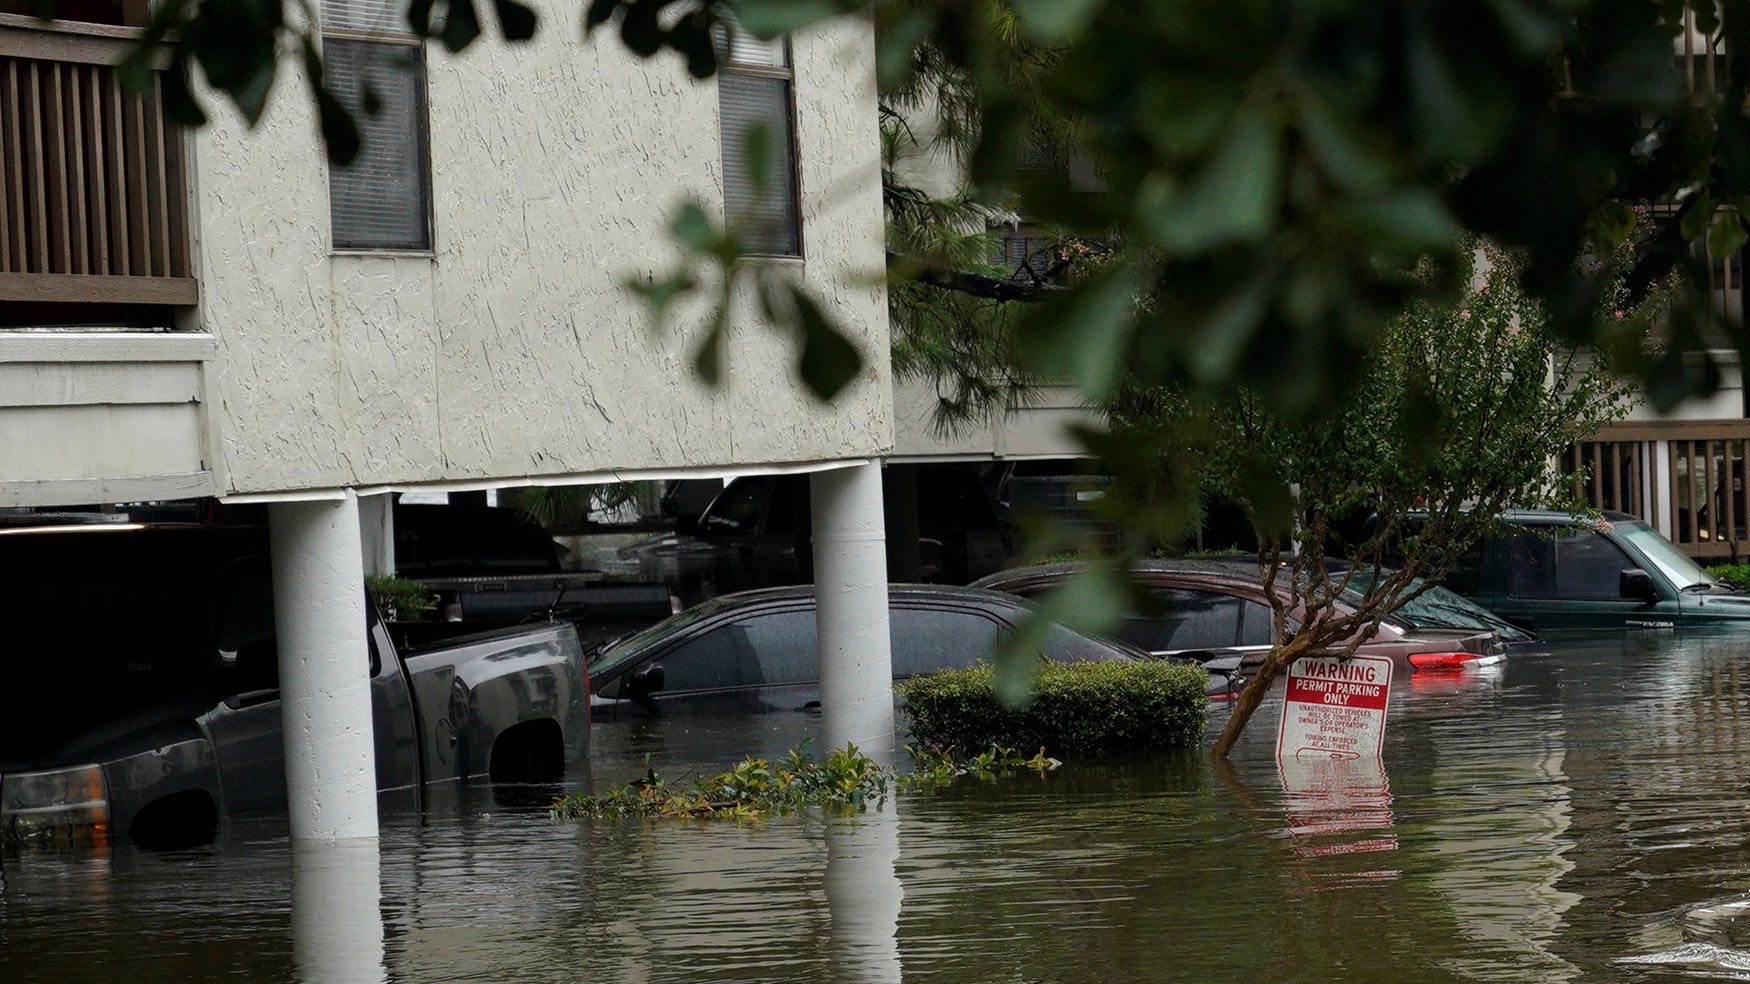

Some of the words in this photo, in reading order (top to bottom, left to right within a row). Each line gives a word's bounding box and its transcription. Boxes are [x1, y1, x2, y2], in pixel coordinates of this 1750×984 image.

[1305, 661, 1376, 682] WARNING
[1296, 679, 1334, 692] PERMIT
[1336, 683, 1380, 697] PARKING
[1323, 693, 1350, 705] ONLY
[1299, 705, 1343, 714] UNAUTHORIZED
[1344, 709, 1371, 717] VEHICLES
[1329, 736, 1358, 744] ENFORCED
